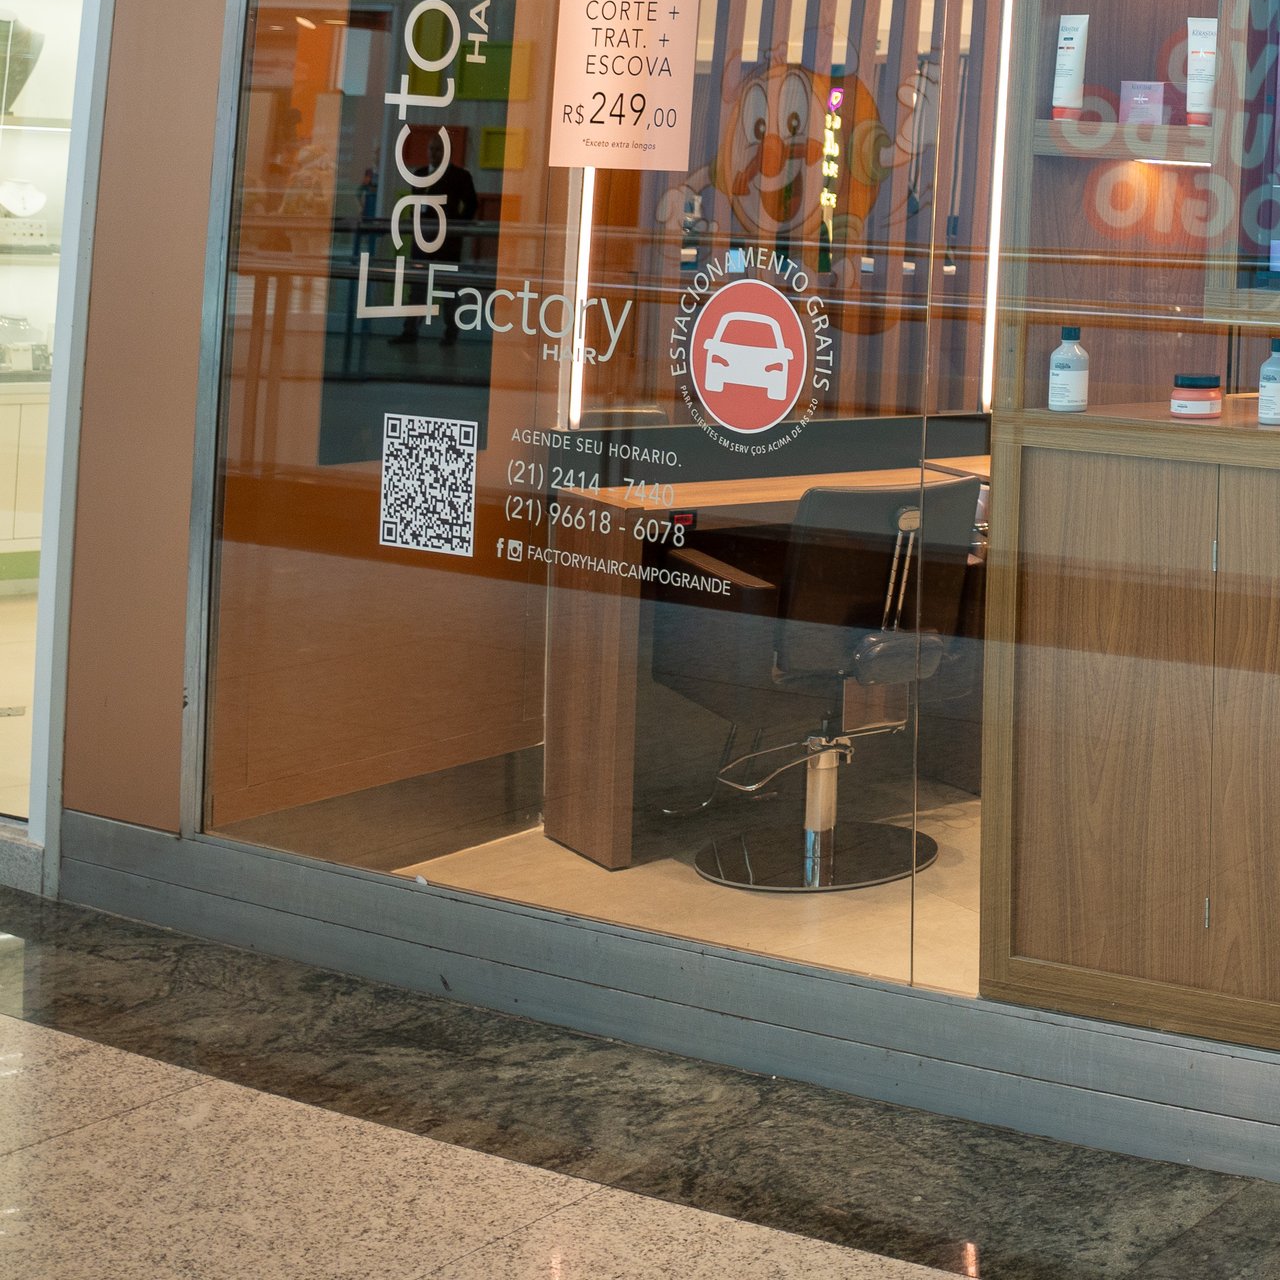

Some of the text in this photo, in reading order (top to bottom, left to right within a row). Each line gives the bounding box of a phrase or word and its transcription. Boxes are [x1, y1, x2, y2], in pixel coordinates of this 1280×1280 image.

[586, 0, 658, 21] CORTE
[592, 28, 646, 49] TRAT.
[586, 55, 672, 77] ESCOVA
[611, 140, 629, 149] extra
[631, 140, 656, 151] longos
[425, 264, 633, 362] Factory
[670, 246, 833, 391] ESTACIONAMENTO GRATIS
[542, 343, 597, 366] HAIR
[680, 384, 692, 409] PARA
[691, 408, 718, 441] CLIENTES
[718, 436, 730, 449] EM
[768, 434, 792, 452] ACIMA
[791, 425, 802, 438] DE
[511, 428, 571, 450] AGENDE
[576, 437, 603, 455] SEU
[507, 459, 544, 490] (21)
[551, 467, 599, 495] 2414
[623, 477, 674, 507] 7440
[505, 495, 542, 526] (21)
[549, 503, 611, 534] 96618
[633, 518, 685, 547] 6078
[528, 545, 732, 596] FACTORYHAIRCAMPOGRANDE
